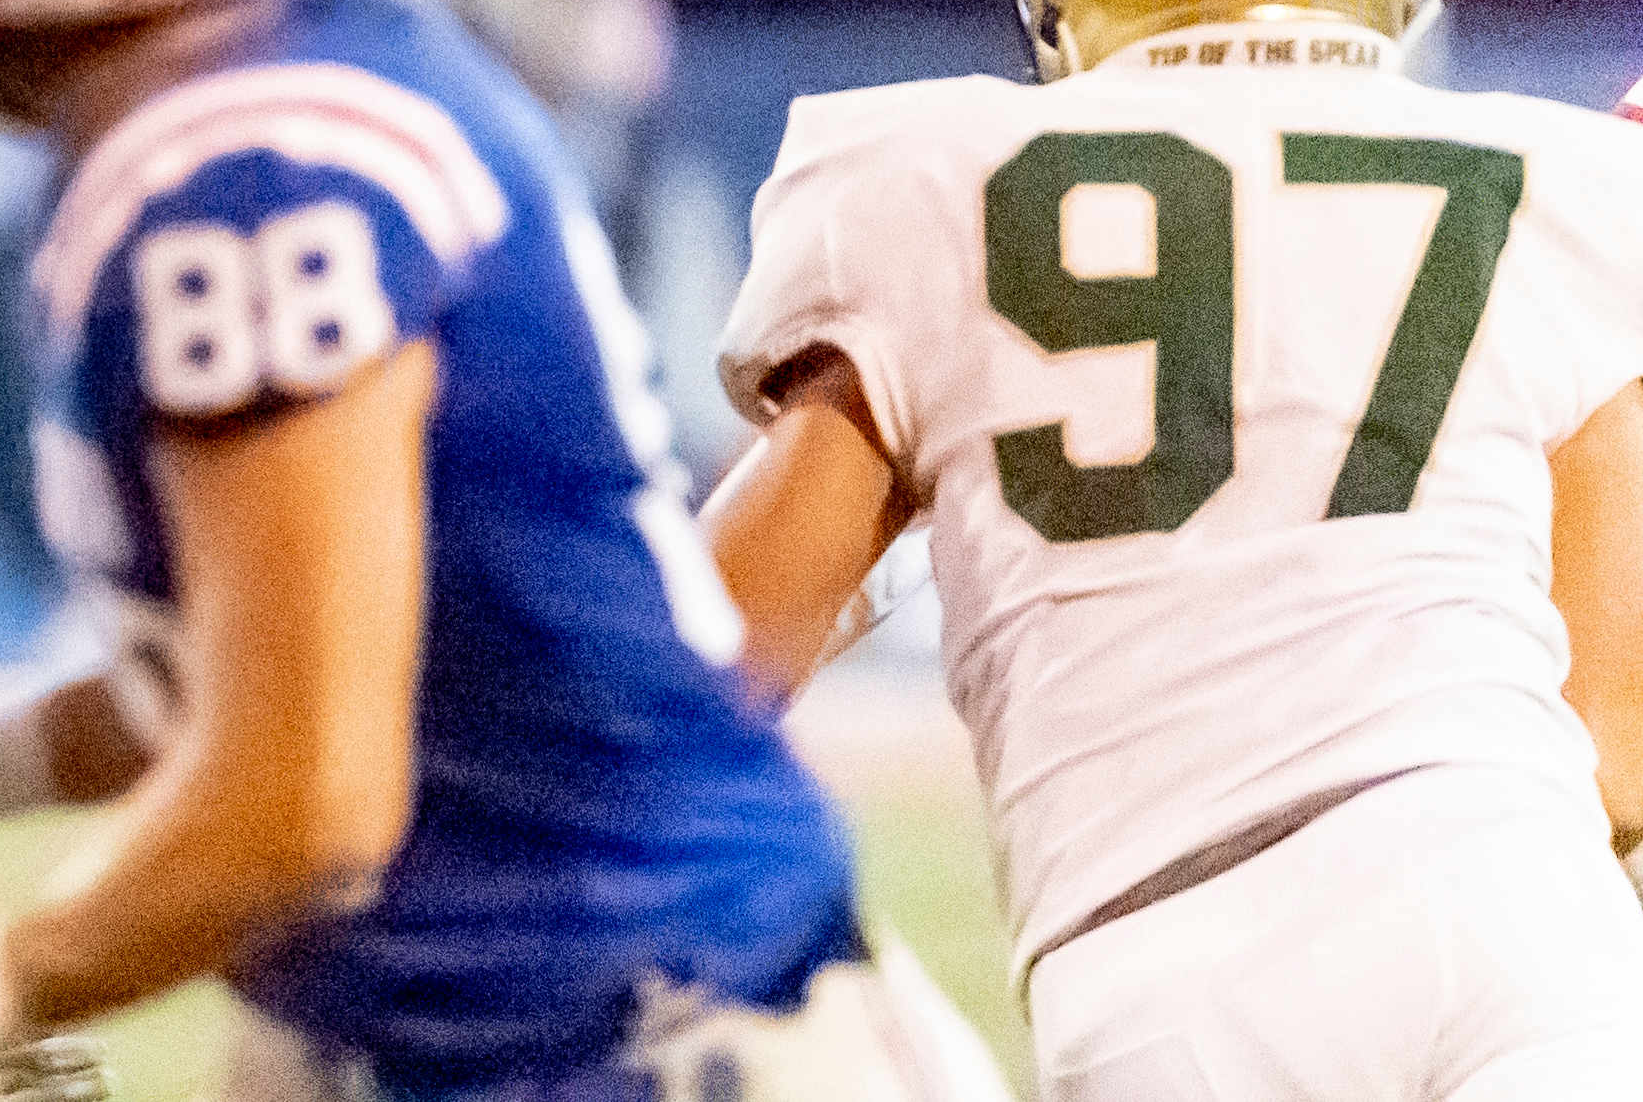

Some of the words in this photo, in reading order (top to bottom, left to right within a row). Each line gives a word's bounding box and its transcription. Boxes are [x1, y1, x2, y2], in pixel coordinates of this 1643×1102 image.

[1246, 39, 1297, 66] THE
[137, 202, 394, 414] 88
[985, 130, 1525, 544] 97
